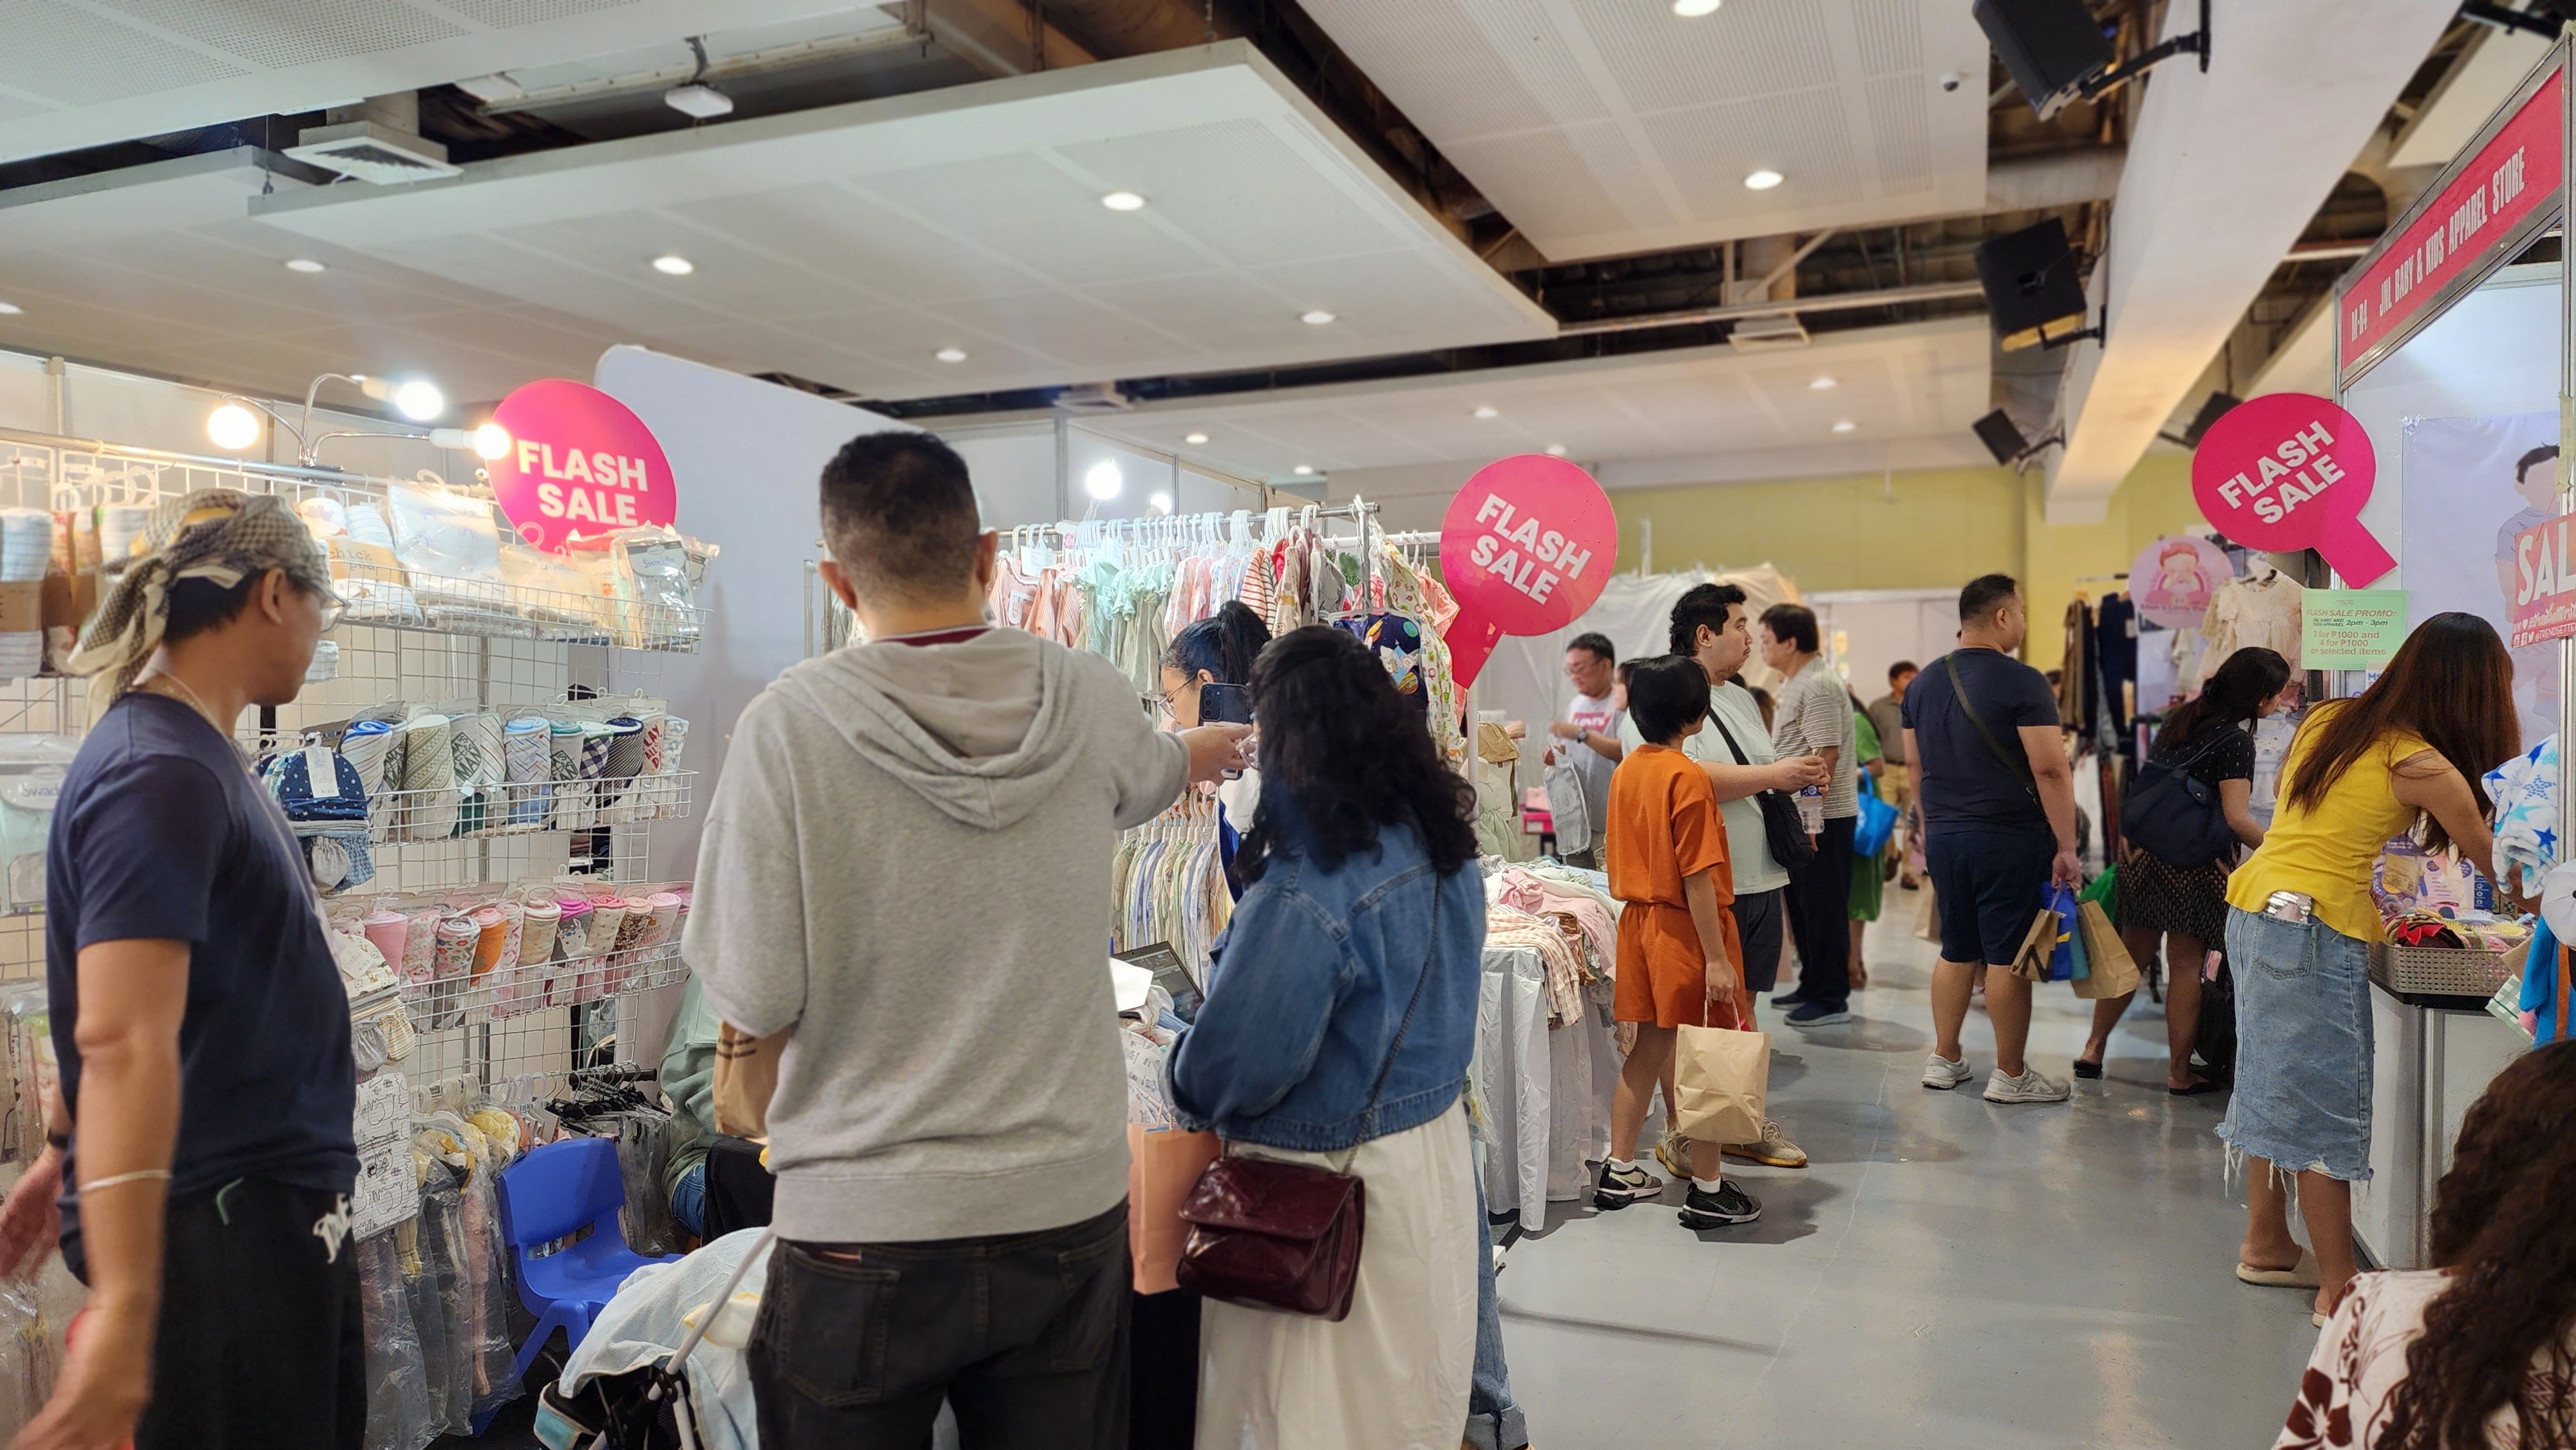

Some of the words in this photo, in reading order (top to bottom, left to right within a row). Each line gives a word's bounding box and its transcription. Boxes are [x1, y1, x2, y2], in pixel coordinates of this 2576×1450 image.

[2395, 254, 2414, 303] BABY
[2416, 247, 2423, 284] &
[2426, 225, 2445, 276] KIDS
[2448, 184, 2488, 256] APPAREL
[2492, 146, 2525, 214] STORE
[517, 438, 648, 492] FLASH
[2217, 420, 2335, 509] FLASH
[2253, 453, 2346, 523] SALE
[537, 482, 638, 527] SALE
[1475, 493, 1592, 580] FLASH
[1470, 534, 1560, 605] SALE
